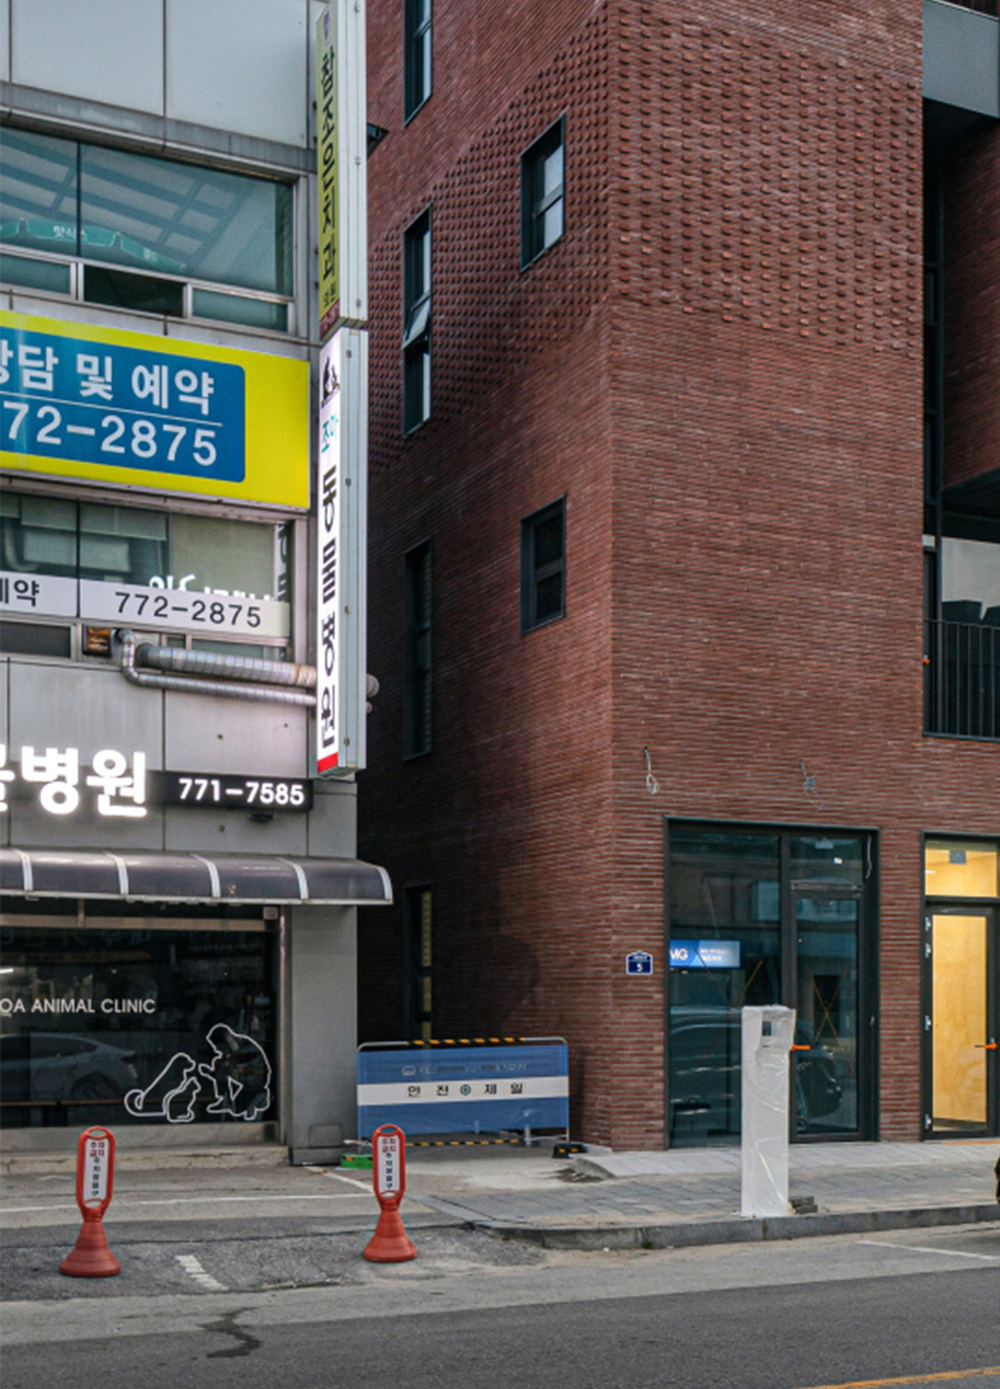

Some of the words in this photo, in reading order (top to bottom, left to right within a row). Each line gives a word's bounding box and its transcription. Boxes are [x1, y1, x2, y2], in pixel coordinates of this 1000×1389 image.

[76, 353, 114, 401] 및
[131, 364, 215, 416] 예약
[115, 591, 262, 628] 772-2875
[321, 464, 338, 750] 동물병원
[178, 777, 305, 806] 771-7585
[31, 998, 96, 1014] ANIMAL
[100, 998, 156, 1014] CLINIC
